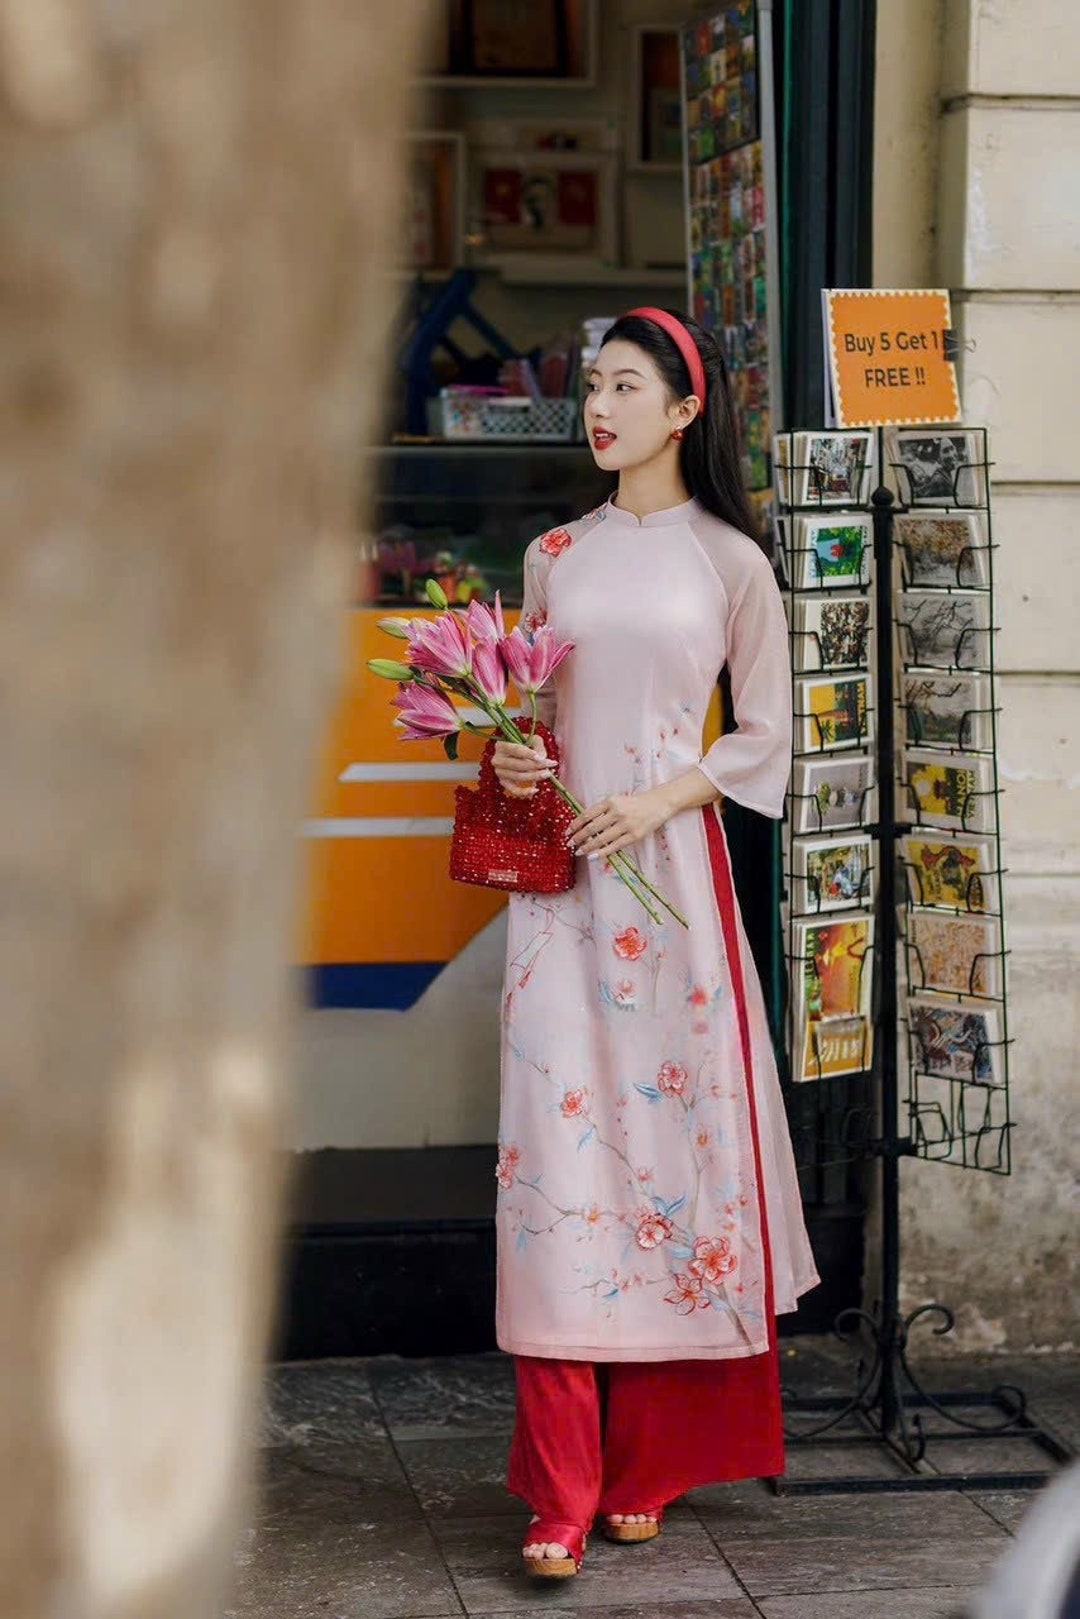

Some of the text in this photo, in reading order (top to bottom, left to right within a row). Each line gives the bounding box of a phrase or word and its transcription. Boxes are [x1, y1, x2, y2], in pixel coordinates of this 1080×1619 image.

[844, 330, 938, 356] Buy 5 Get 1
[864, 367, 926, 388] FREE !!
